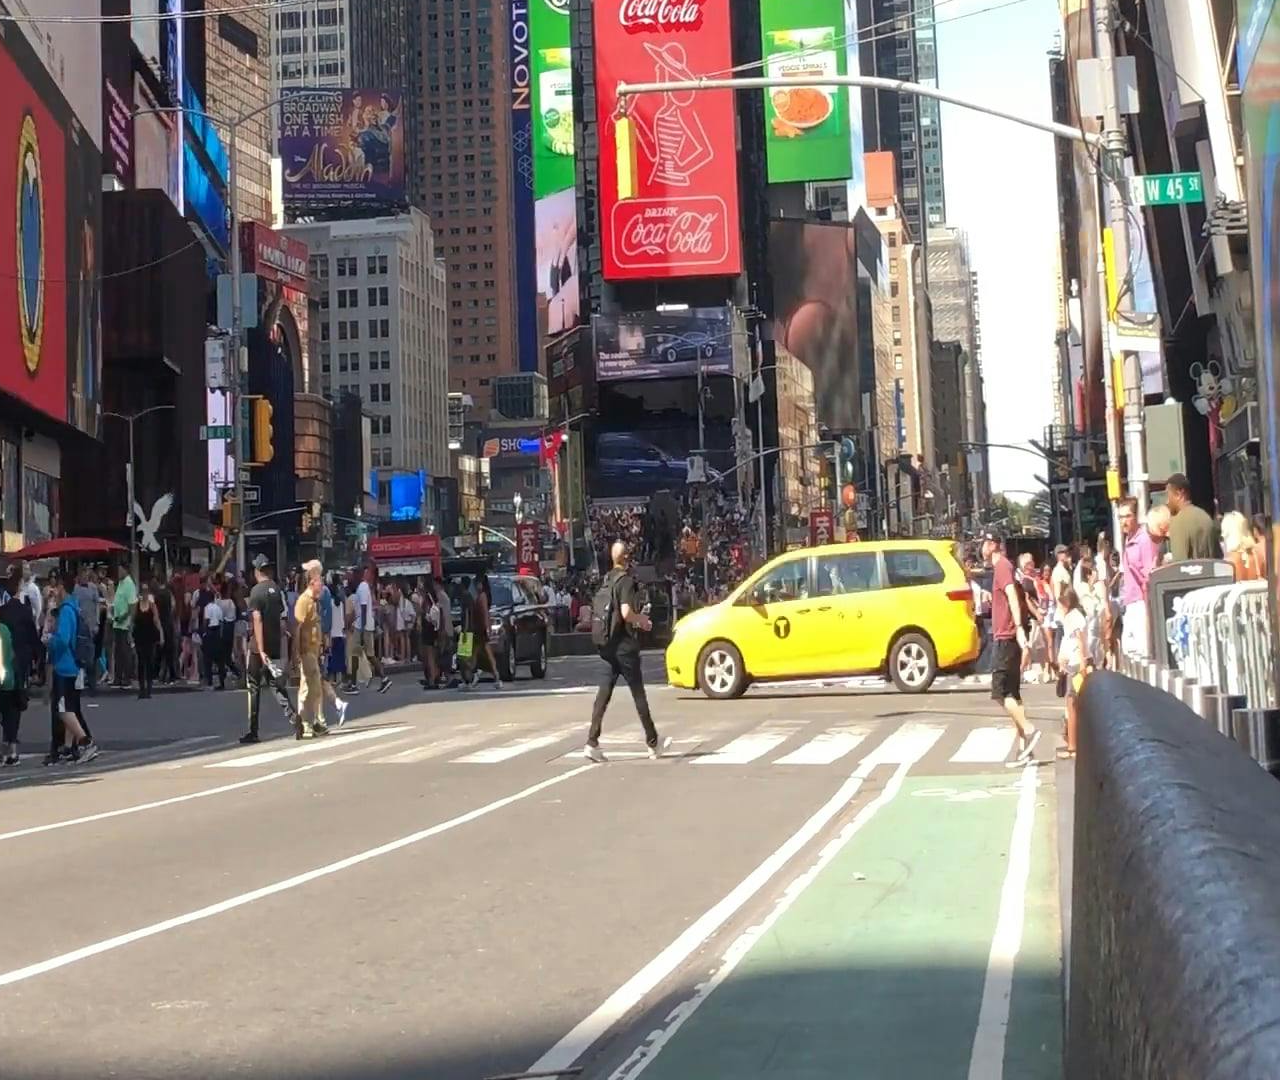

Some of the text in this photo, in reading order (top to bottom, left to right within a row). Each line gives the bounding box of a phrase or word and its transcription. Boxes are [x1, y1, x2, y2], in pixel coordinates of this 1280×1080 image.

[282, 102, 343, 113] BROADWAY
[283, 113, 343, 125] ONE WISH
[284, 125, 340, 137] AT A TIME
[1146, 177, 1199, 201] W 45 St
[644, 207, 678, 217] DRINK
[622, 211, 718, 255] Coca-Cola
